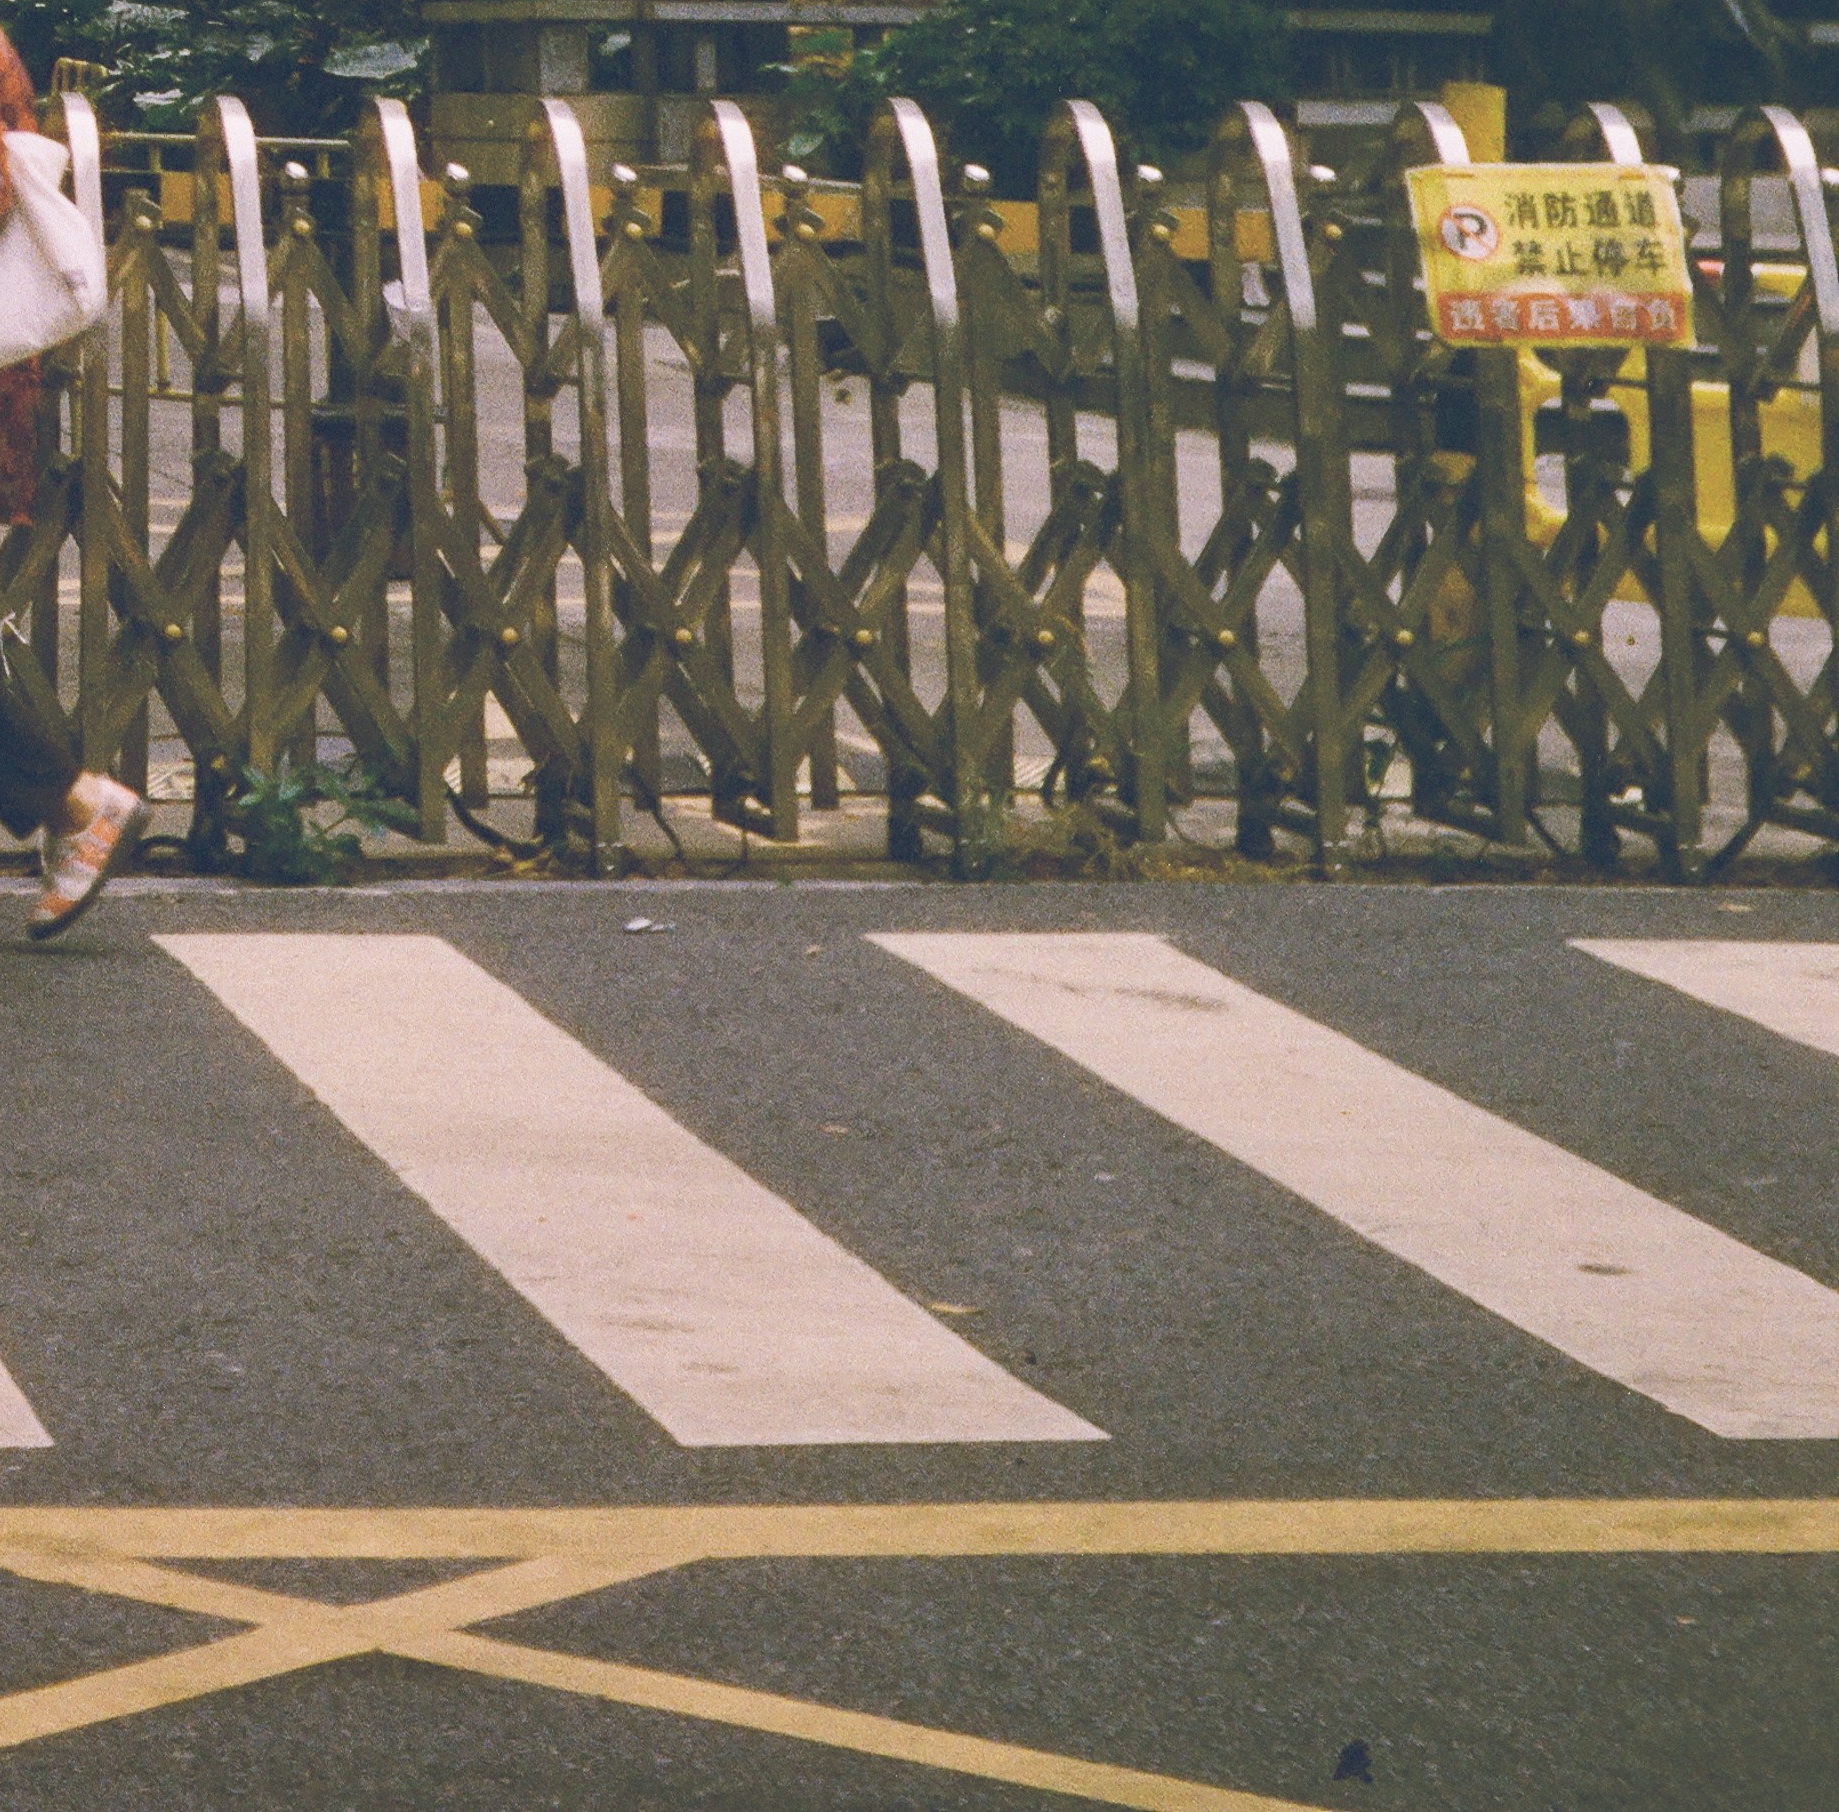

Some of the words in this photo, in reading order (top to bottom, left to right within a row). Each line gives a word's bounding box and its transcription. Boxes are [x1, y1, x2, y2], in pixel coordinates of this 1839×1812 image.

[1505, 189, 1659, 230] 消防通道
[1512, 237, 1665, 277] 禁止停车
